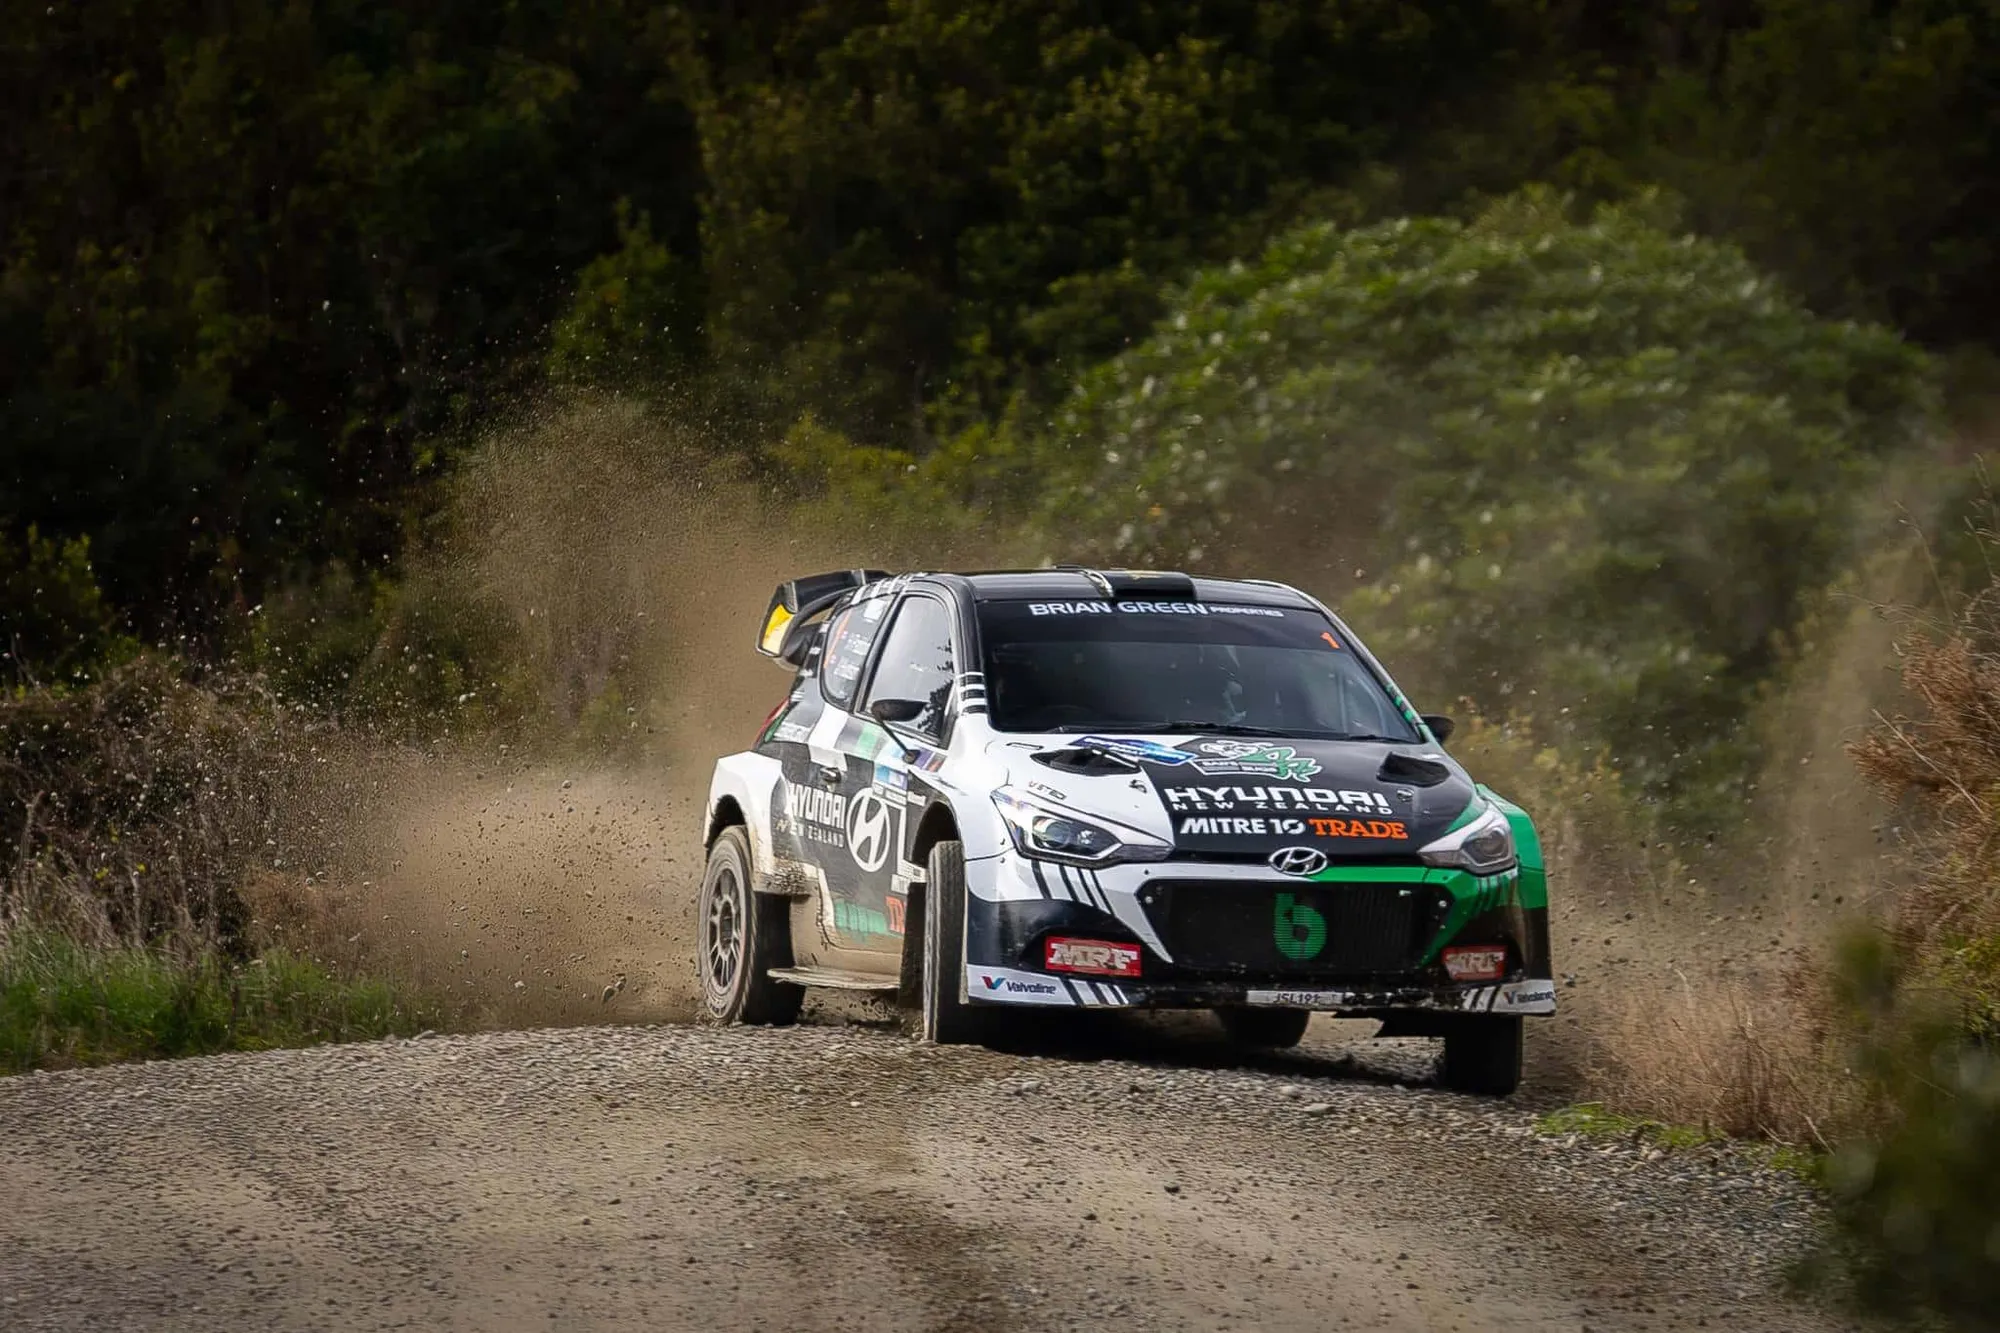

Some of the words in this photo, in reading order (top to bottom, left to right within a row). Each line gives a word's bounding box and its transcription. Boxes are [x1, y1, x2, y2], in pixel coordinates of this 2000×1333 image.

[1029, 601, 1112, 616] BRIAN
[1116, 601, 1209, 615] GREEN
[1209, 606, 1284, 618] PROPERTIES
[1320, 631, 1340, 649] 1
[784, 780, 846, 829] HYUNDAI
[1163, 786, 1390, 807] HYUNDAI
[1172, 801, 1234, 811] NEW
[1256, 801, 1393, 815] ZEALAND
[1179, 818, 1266, 835] MITRE
[1269, 818, 1307, 835] 10
[1307, 818, 1409, 840] TRADE
[1048, 943, 1138, 970] MRF
[1007, 981, 1057, 994] Valvoline
